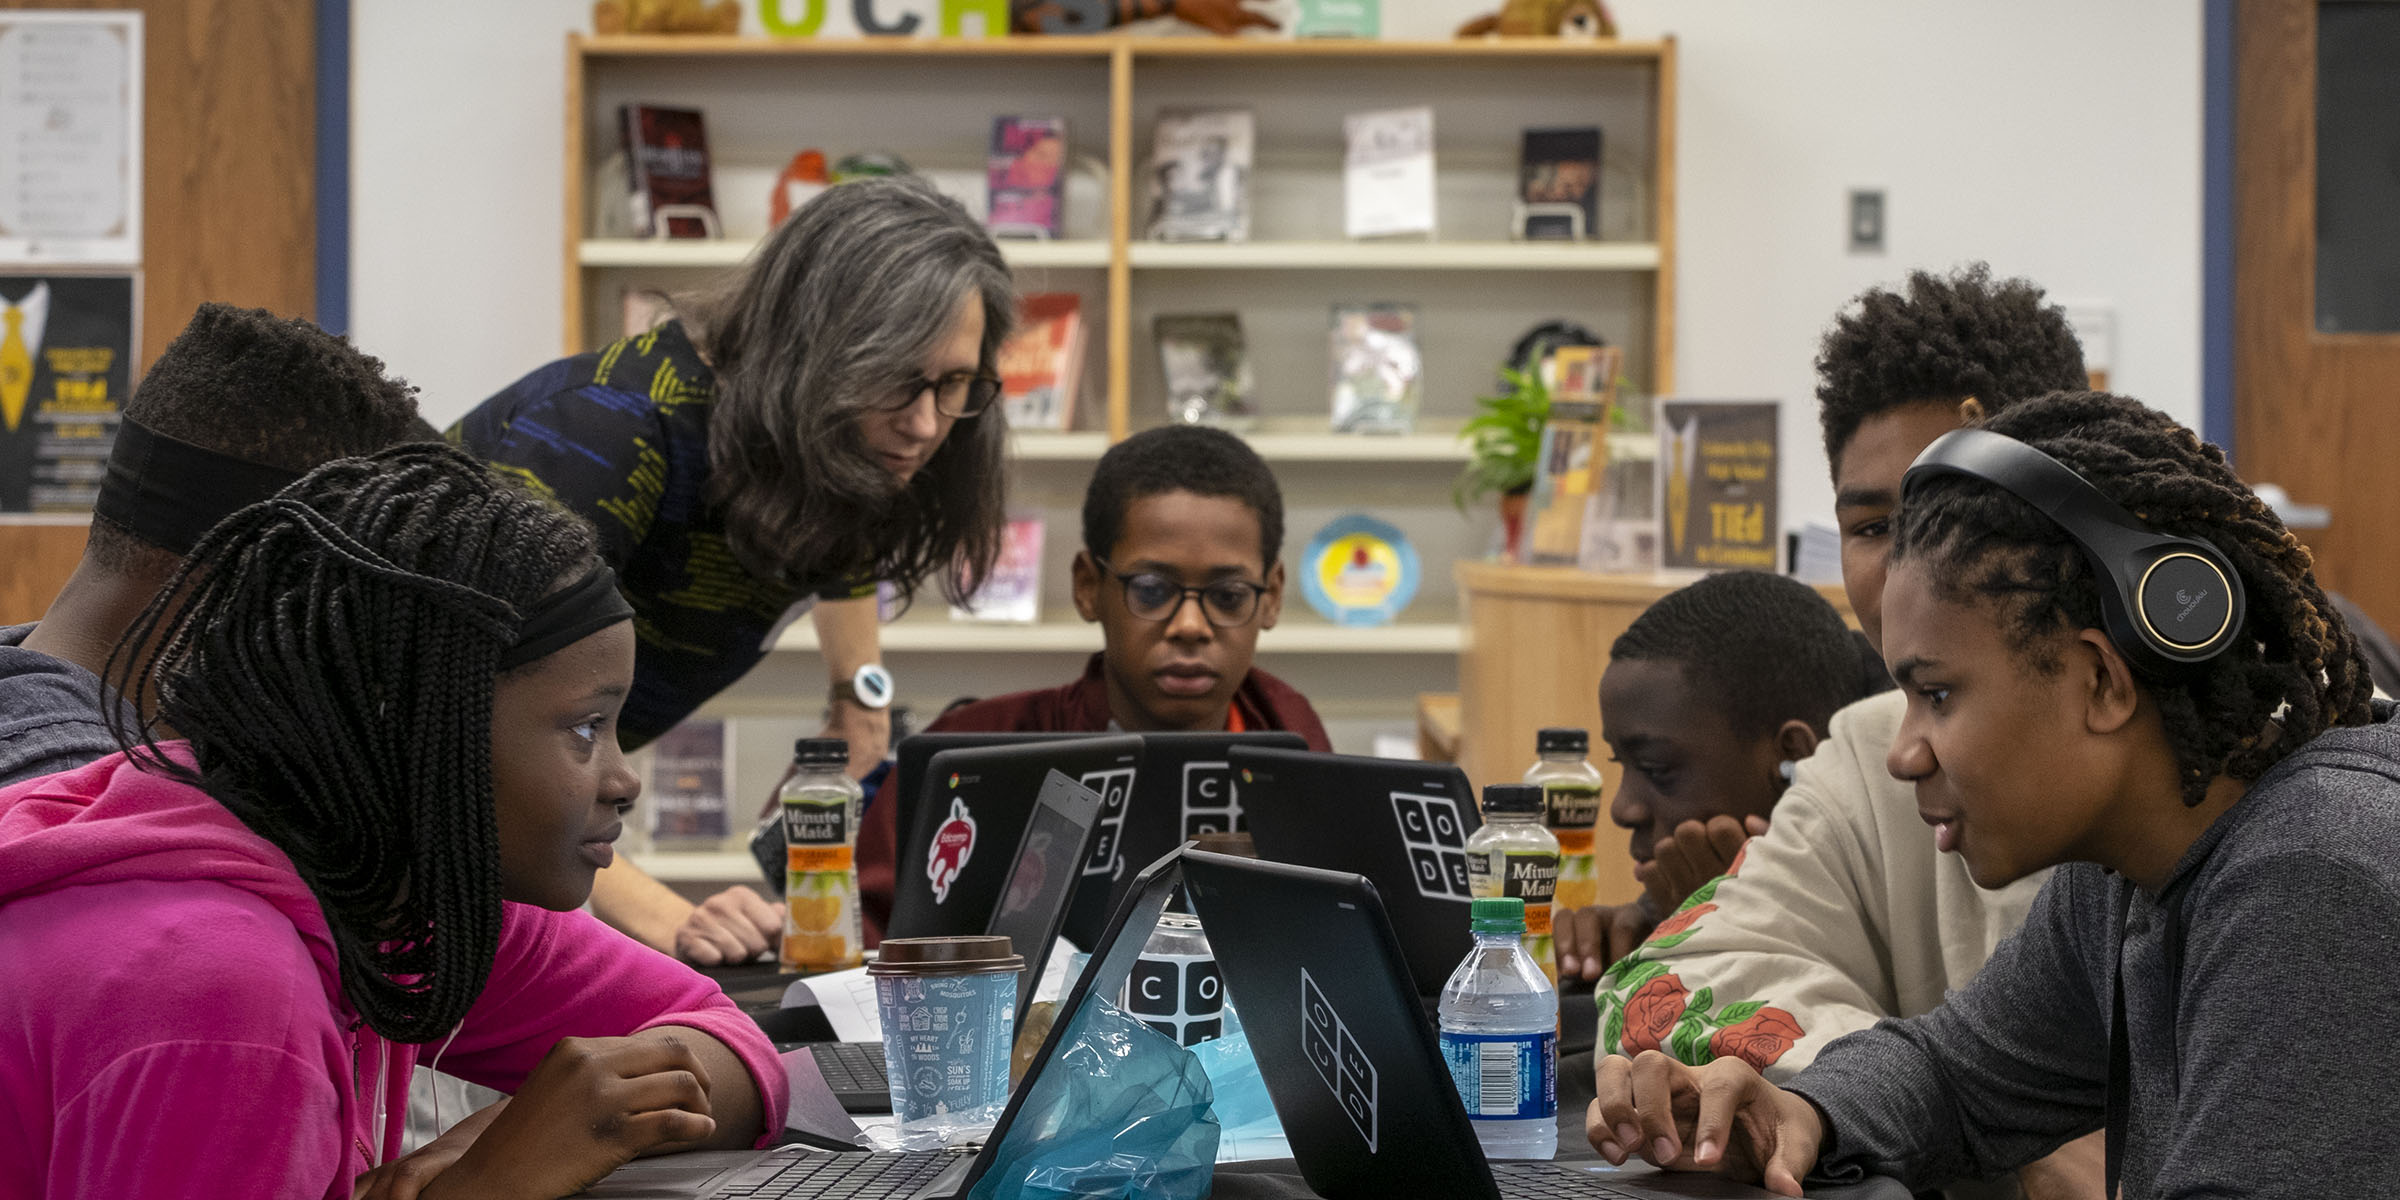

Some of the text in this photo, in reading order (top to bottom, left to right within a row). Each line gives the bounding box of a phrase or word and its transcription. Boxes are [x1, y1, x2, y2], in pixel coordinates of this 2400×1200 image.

[787, 809, 841, 825] Minute
[793, 825, 835, 840] Maid
[1512, 862, 1559, 880] Minut
[1519, 880, 1555, 897] Maid
